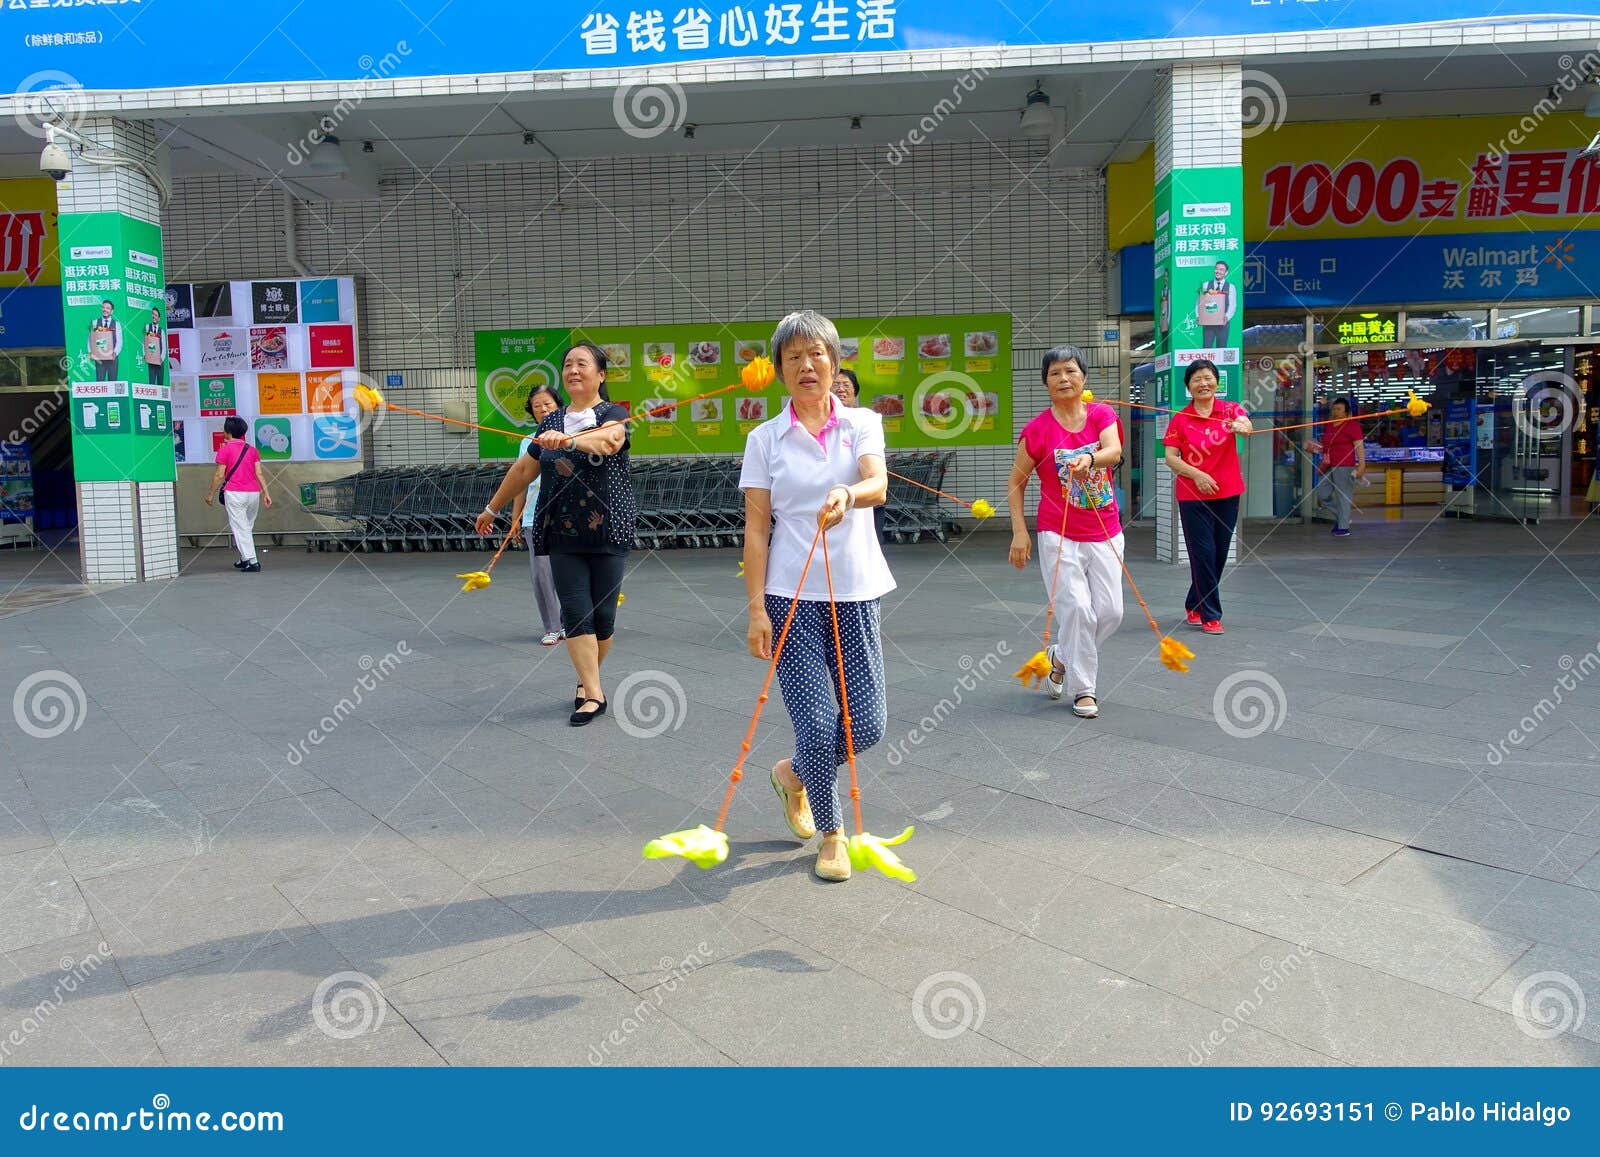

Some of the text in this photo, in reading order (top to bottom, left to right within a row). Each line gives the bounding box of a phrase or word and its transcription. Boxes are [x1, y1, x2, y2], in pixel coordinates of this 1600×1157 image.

[581, 0, 898, 55] 省钱省心好生活
[1175, 222, 1226, 237] 逛沃尔玛
[1175, 238, 1240, 253] 用京东到家
[1443, 244, 1538, 267] Walmart
[65, 265, 109, 278] 逛沃尔玛
[1278, 257, 1337, 277] 出口
[66, 279, 121, 292] 用京东到家
[1293, 278, 1321, 292] Exit
[1443, 268, 1539, 290] 沃尔玛
[1338, 319, 1396, 336] 中国黄金
[501, 336, 536, 346] Walmart
[1339, 335, 1369, 345] CHINA
[1178, 352, 1217, 361] 天天95折
